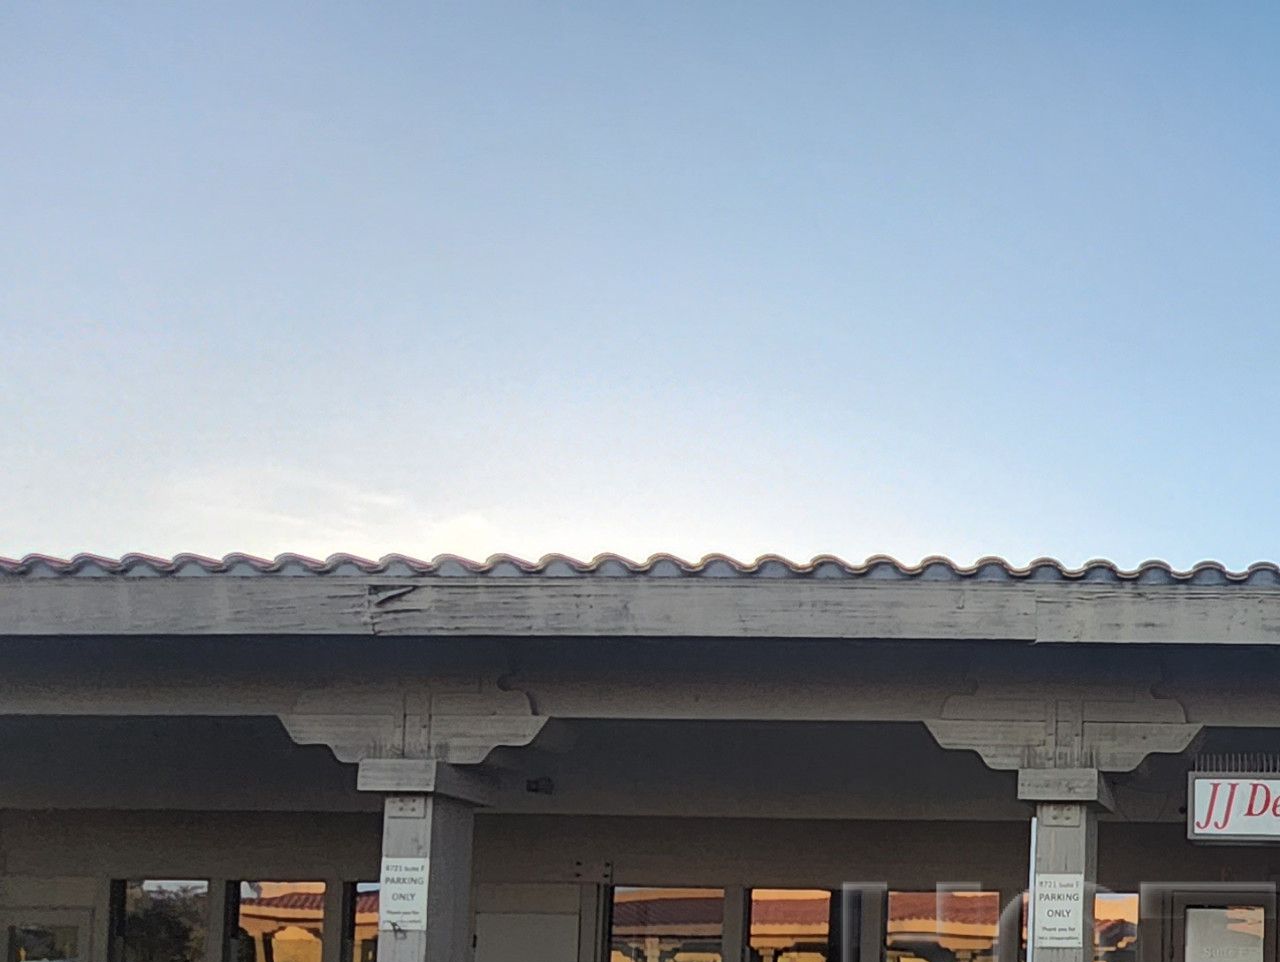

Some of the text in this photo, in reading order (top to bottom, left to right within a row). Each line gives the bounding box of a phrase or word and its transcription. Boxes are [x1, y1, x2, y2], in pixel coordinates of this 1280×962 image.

[1196, 782, 1239, 830] JJ
[384, 877, 425, 885] PARKING
[391, 893, 416, 901] ONLY
[1039, 893, 1080, 901] PARKING
[1046, 909, 1072, 918] ONLY
